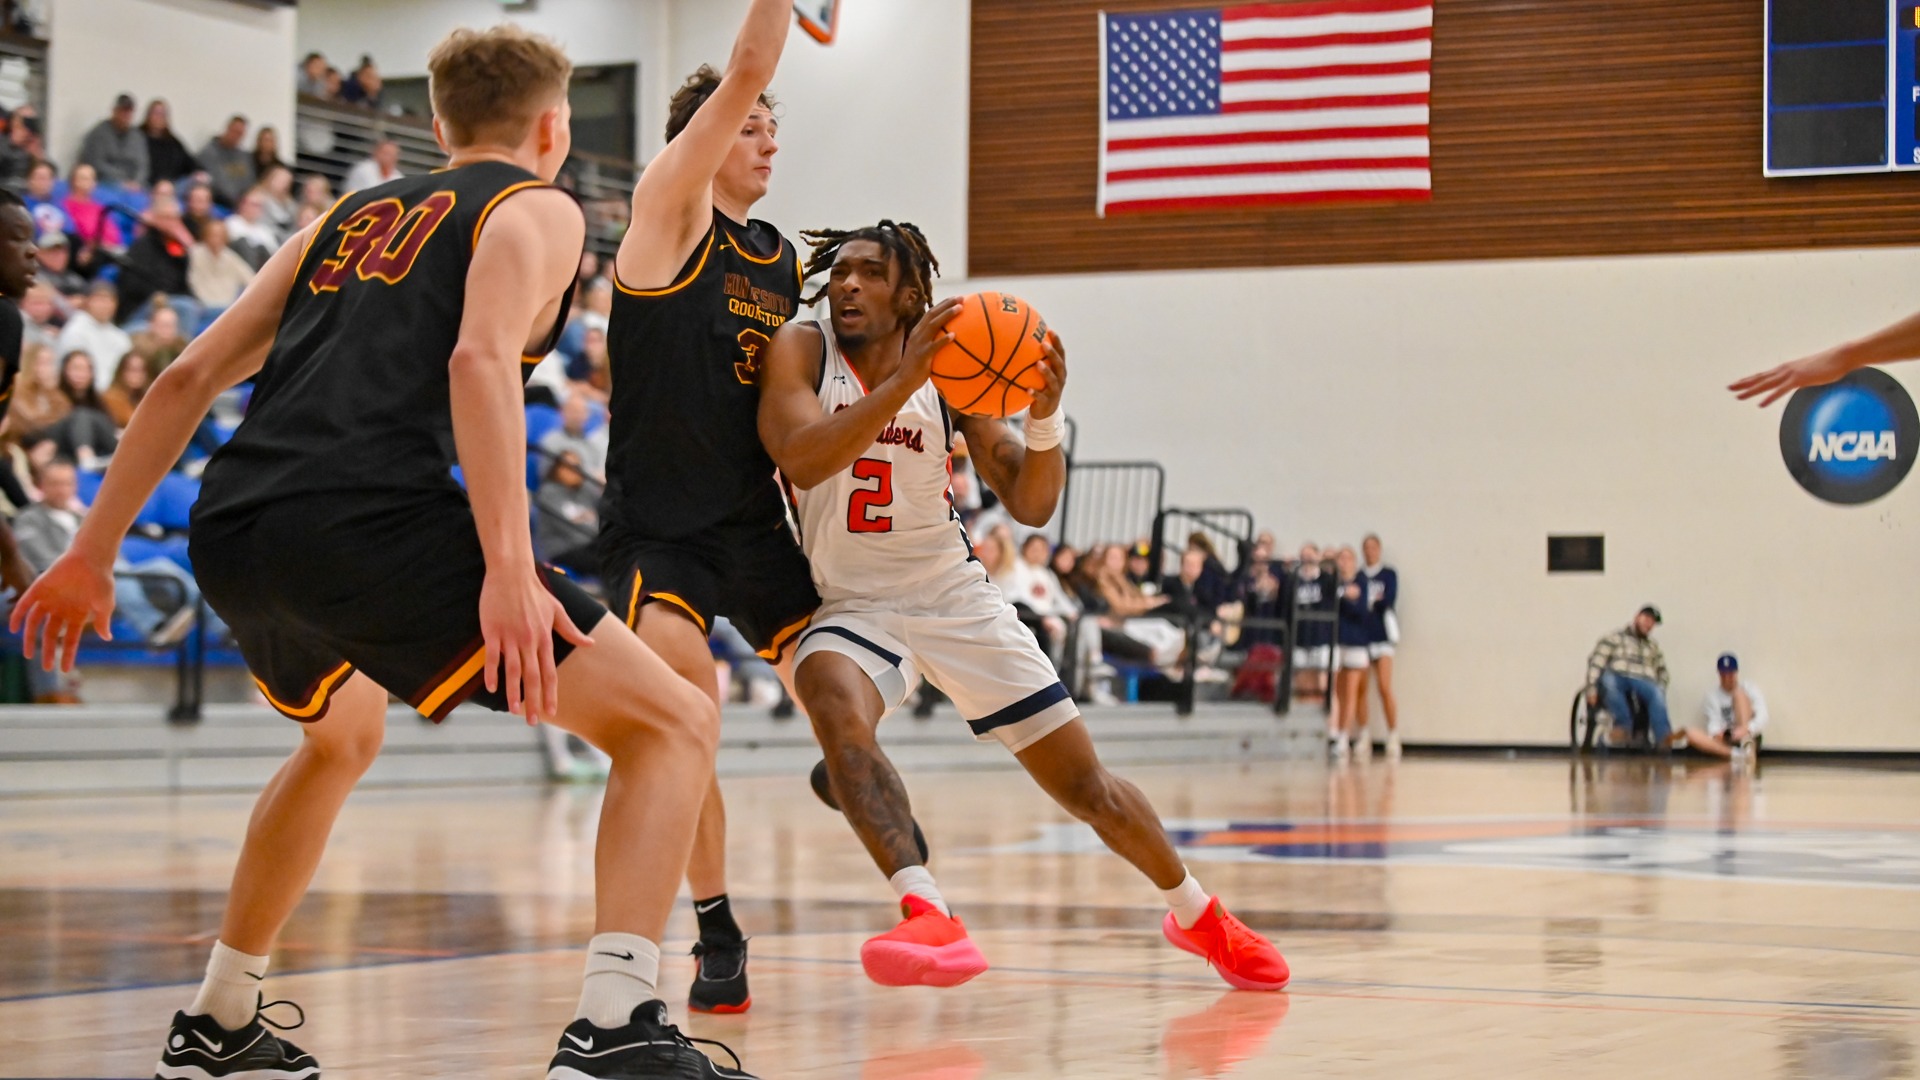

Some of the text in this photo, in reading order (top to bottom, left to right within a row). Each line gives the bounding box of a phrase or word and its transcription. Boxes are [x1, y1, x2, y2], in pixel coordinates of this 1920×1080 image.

[309, 190, 456, 295] 30
[723, 272, 790, 315] MINESOT
[1809, 430, 1897, 462] NCAA
[847, 457, 893, 533] 2
